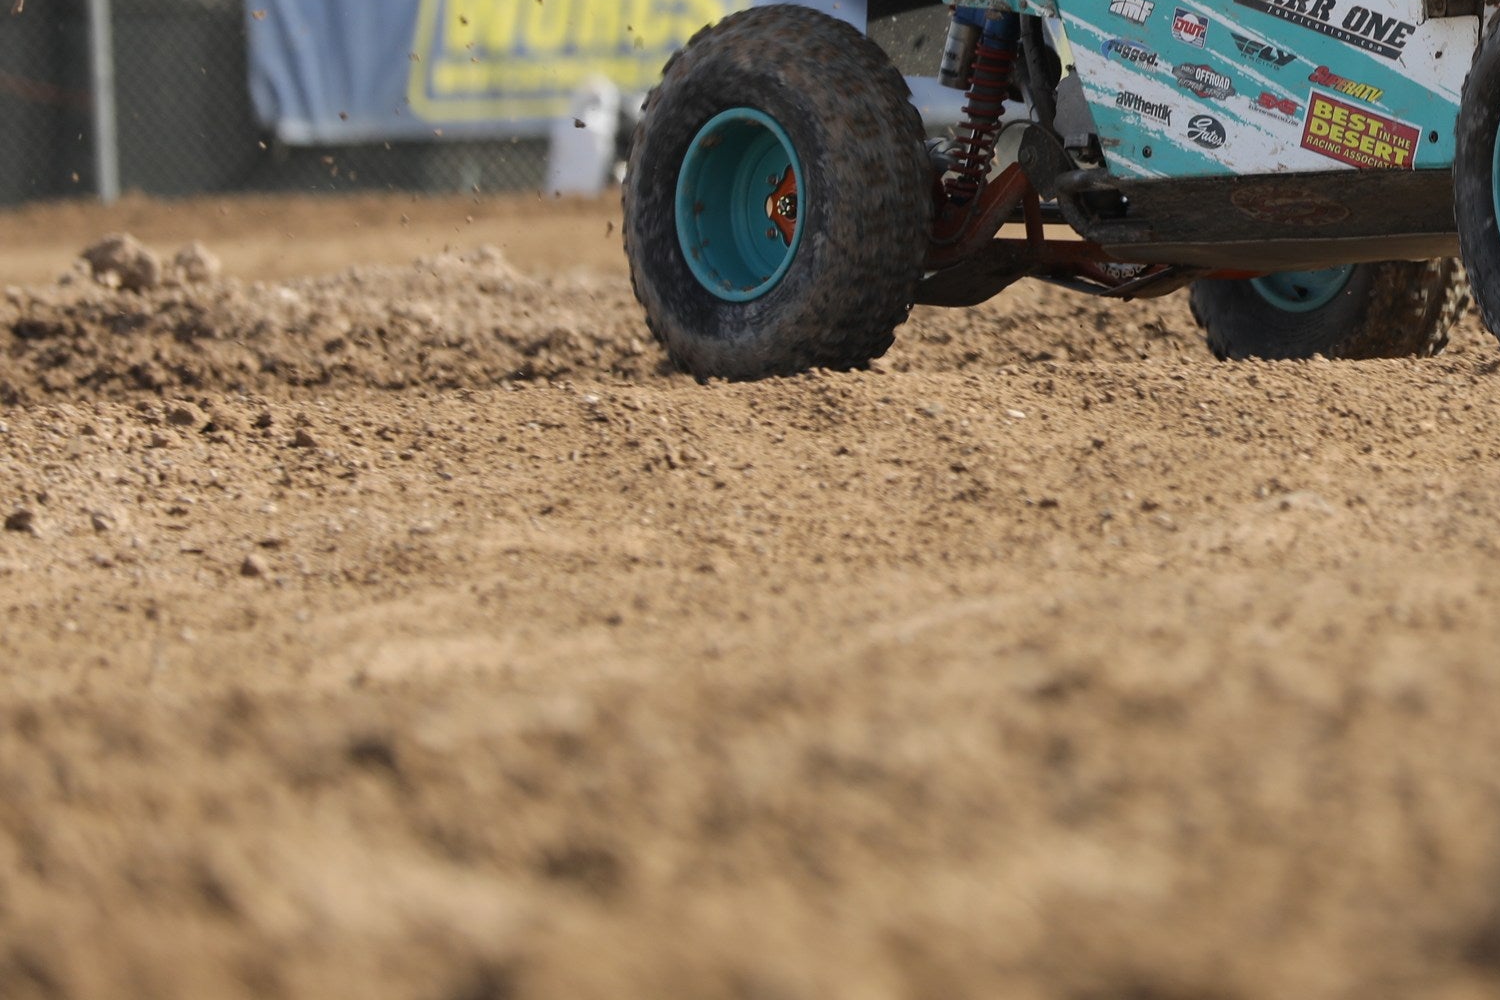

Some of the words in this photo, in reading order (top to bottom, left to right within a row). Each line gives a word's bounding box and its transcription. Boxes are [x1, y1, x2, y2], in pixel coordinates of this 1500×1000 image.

[1267, 5, 1383, 52] fabrication.com
[1342, 5, 1417, 48] ONE
[1195, 67, 1230, 90] OFFROAD
[1187, 118, 1225, 146] Gates
[1306, 134, 1342, 154] RACING
[1309, 116, 1409, 166] DESERT
[1313, 99, 1383, 138] BEST
[1379, 131, 1391, 142] IN
[1393, 135, 1411, 150] THE
